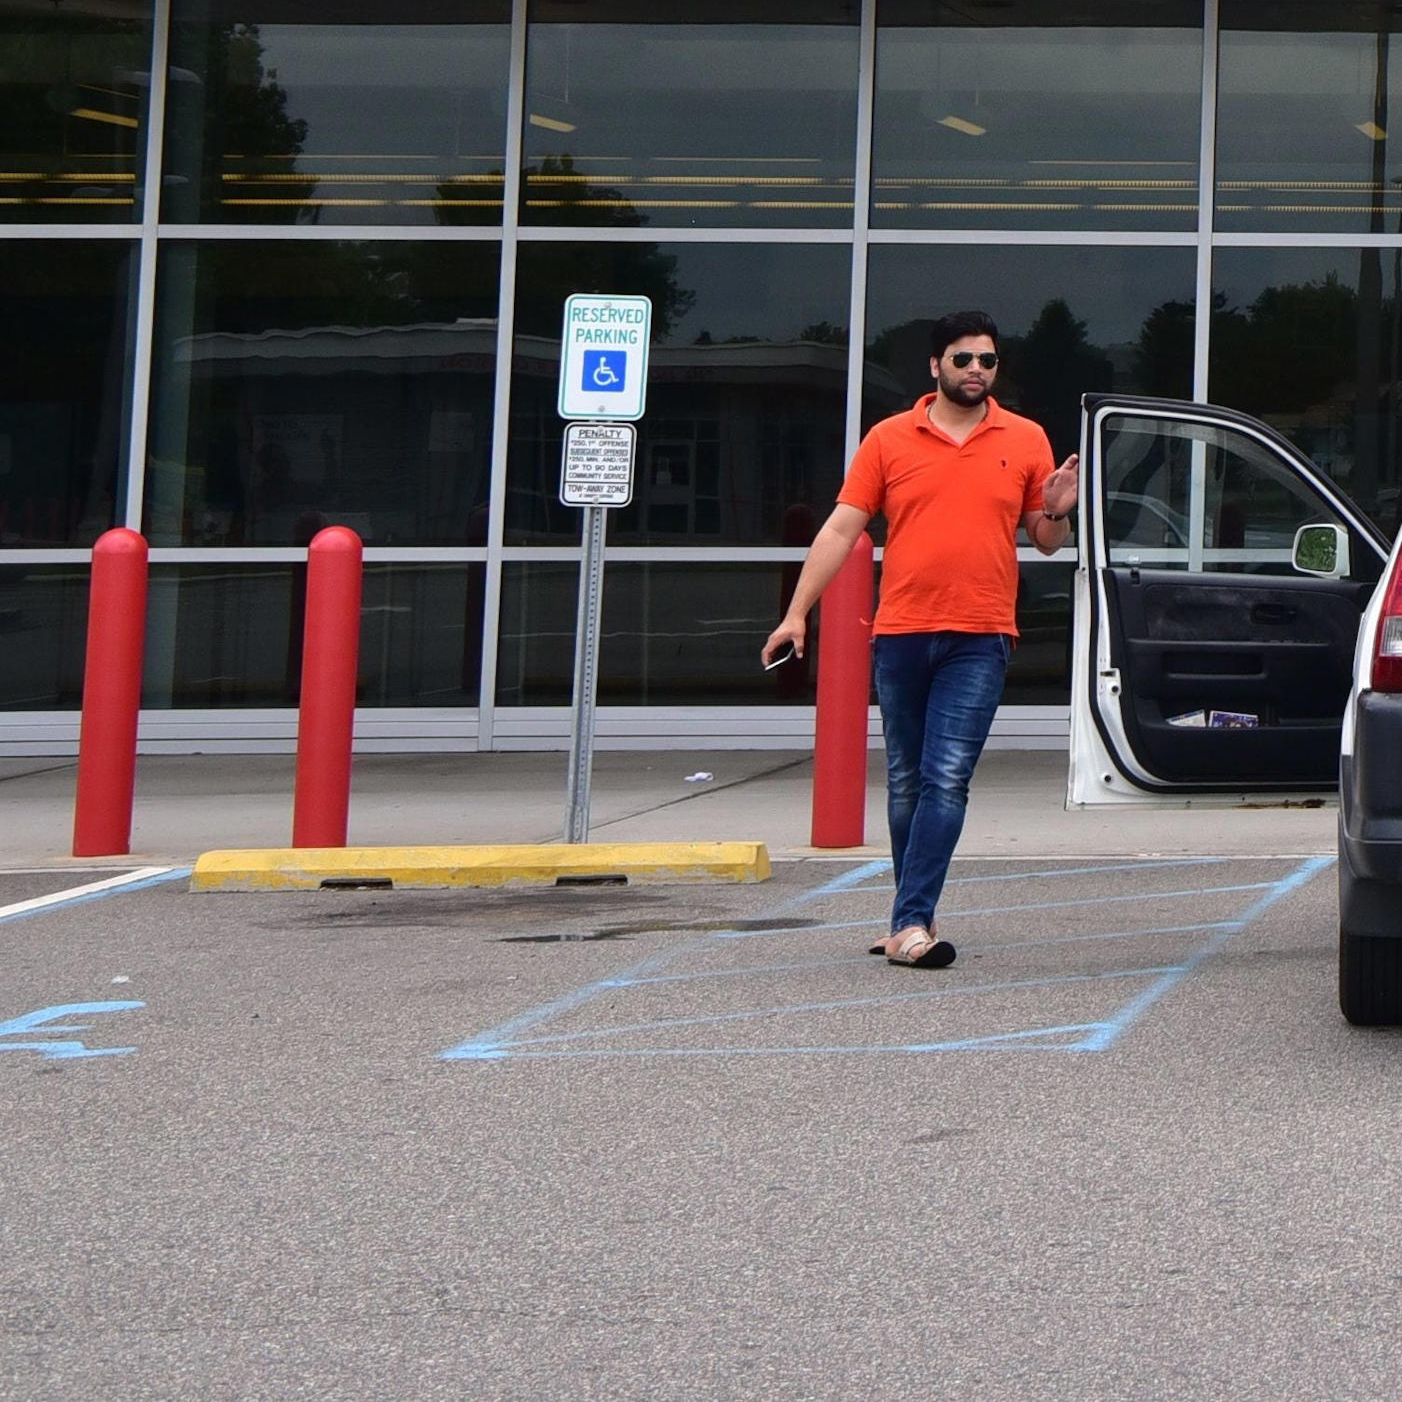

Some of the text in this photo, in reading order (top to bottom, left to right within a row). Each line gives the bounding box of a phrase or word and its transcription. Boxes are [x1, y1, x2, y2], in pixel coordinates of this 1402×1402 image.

[572, 307, 644, 324] RESERVED
[575, 328, 638, 344] PARKING
[579, 429, 622, 438] PENALTY
[567, 484, 604, 493] TOW-AWAY
